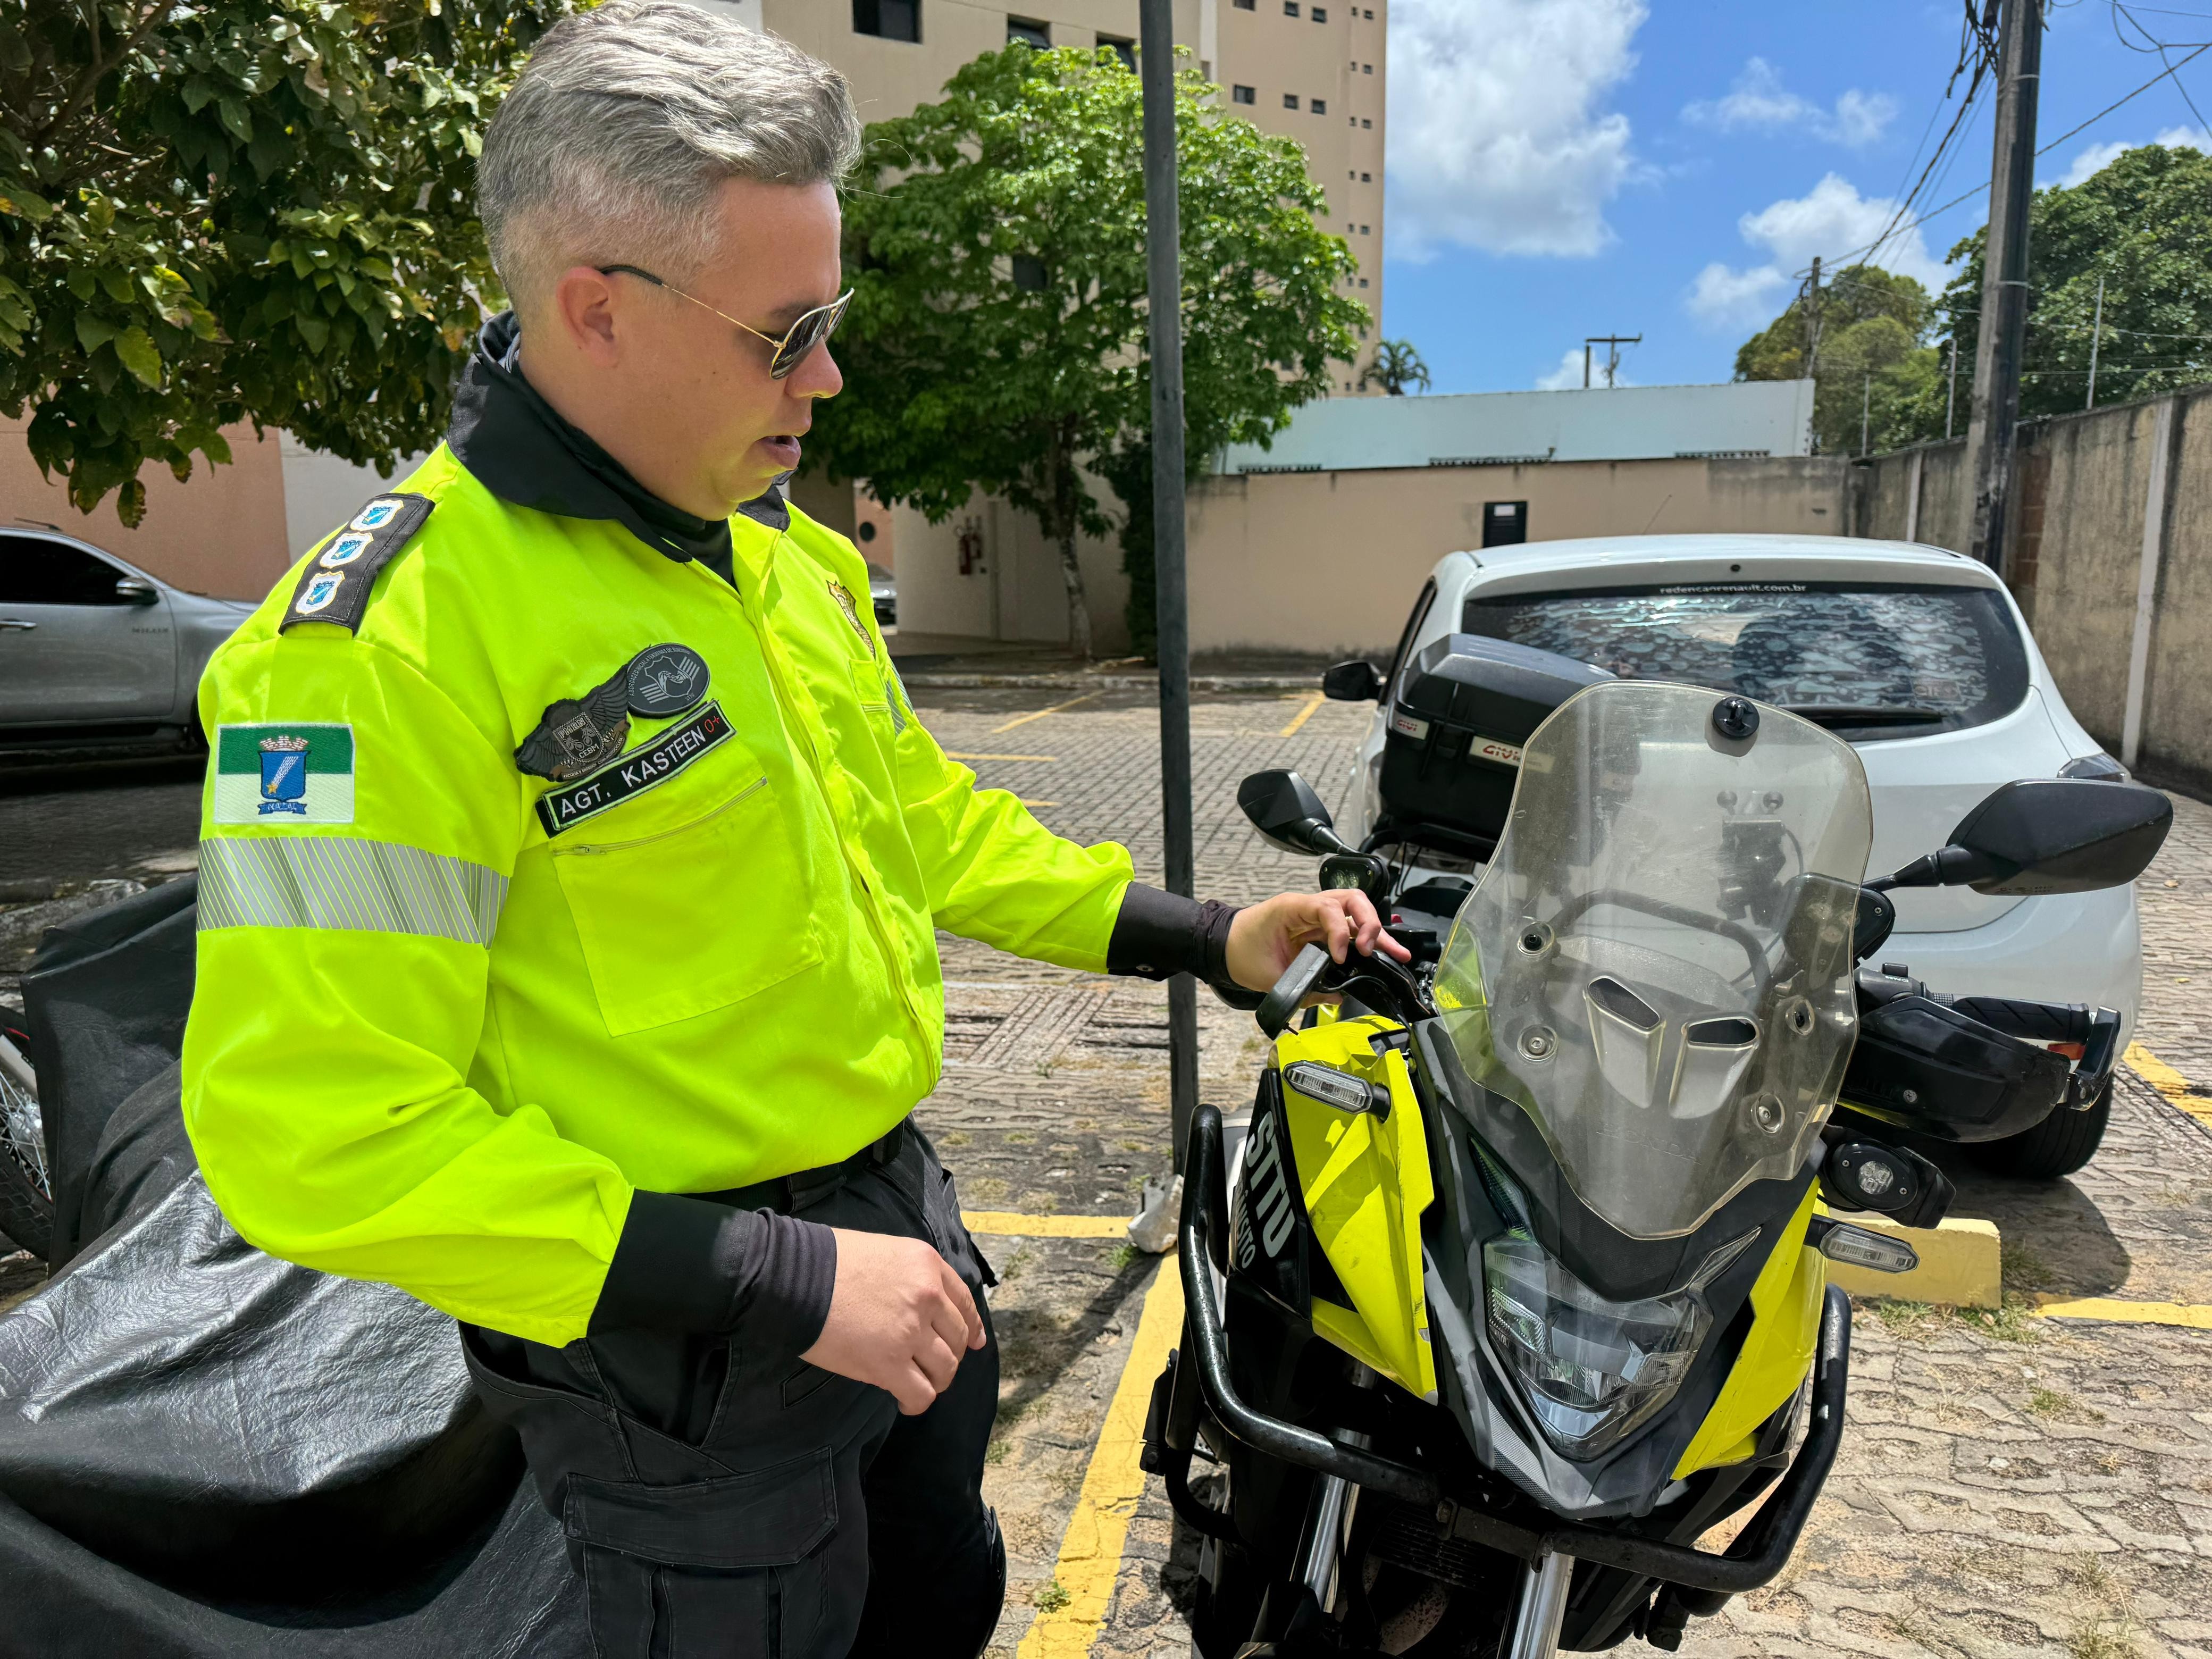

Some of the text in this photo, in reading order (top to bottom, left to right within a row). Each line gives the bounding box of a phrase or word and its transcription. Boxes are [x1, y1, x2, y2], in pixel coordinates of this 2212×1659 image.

[562, 783, 611, 818] AGT.
[621, 725, 706, 789] KASTEEN
[579, 743, 600, 758] CEBM
[1246, 1110, 1295, 1258] STTU
